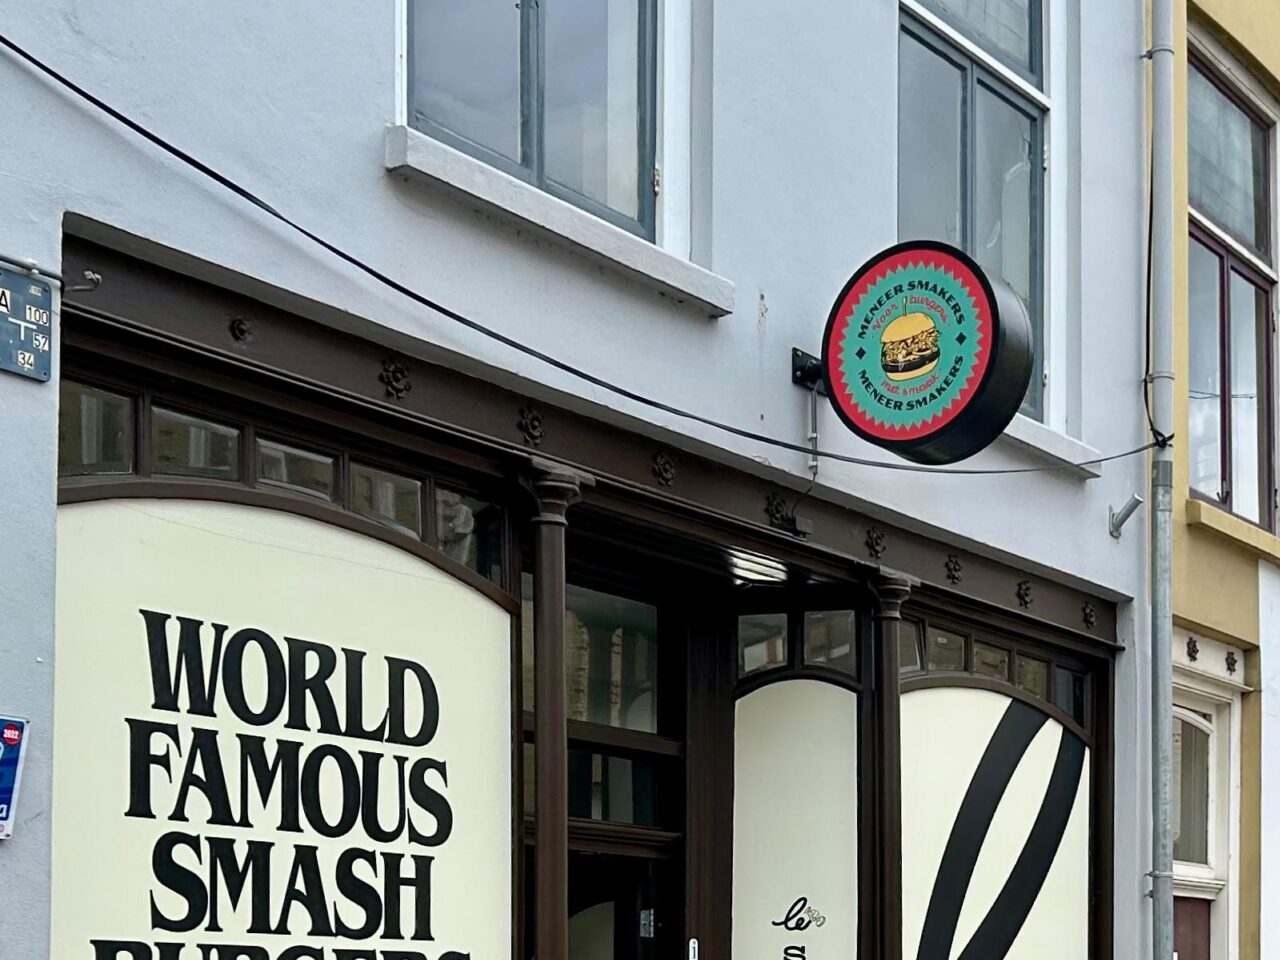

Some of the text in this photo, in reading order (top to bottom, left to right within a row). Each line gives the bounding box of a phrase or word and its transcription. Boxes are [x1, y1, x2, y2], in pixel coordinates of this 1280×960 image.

[27, 306, 49, 325] 100
[857, 280, 965, 339] MENEER SMAKERS
[858, 355, 963, 410] MENEER SMAKERS
[138, 608, 440, 748] WORLD
[123, 717, 454, 847] FAMOUS
[149, 831, 436, 941] SMASH
